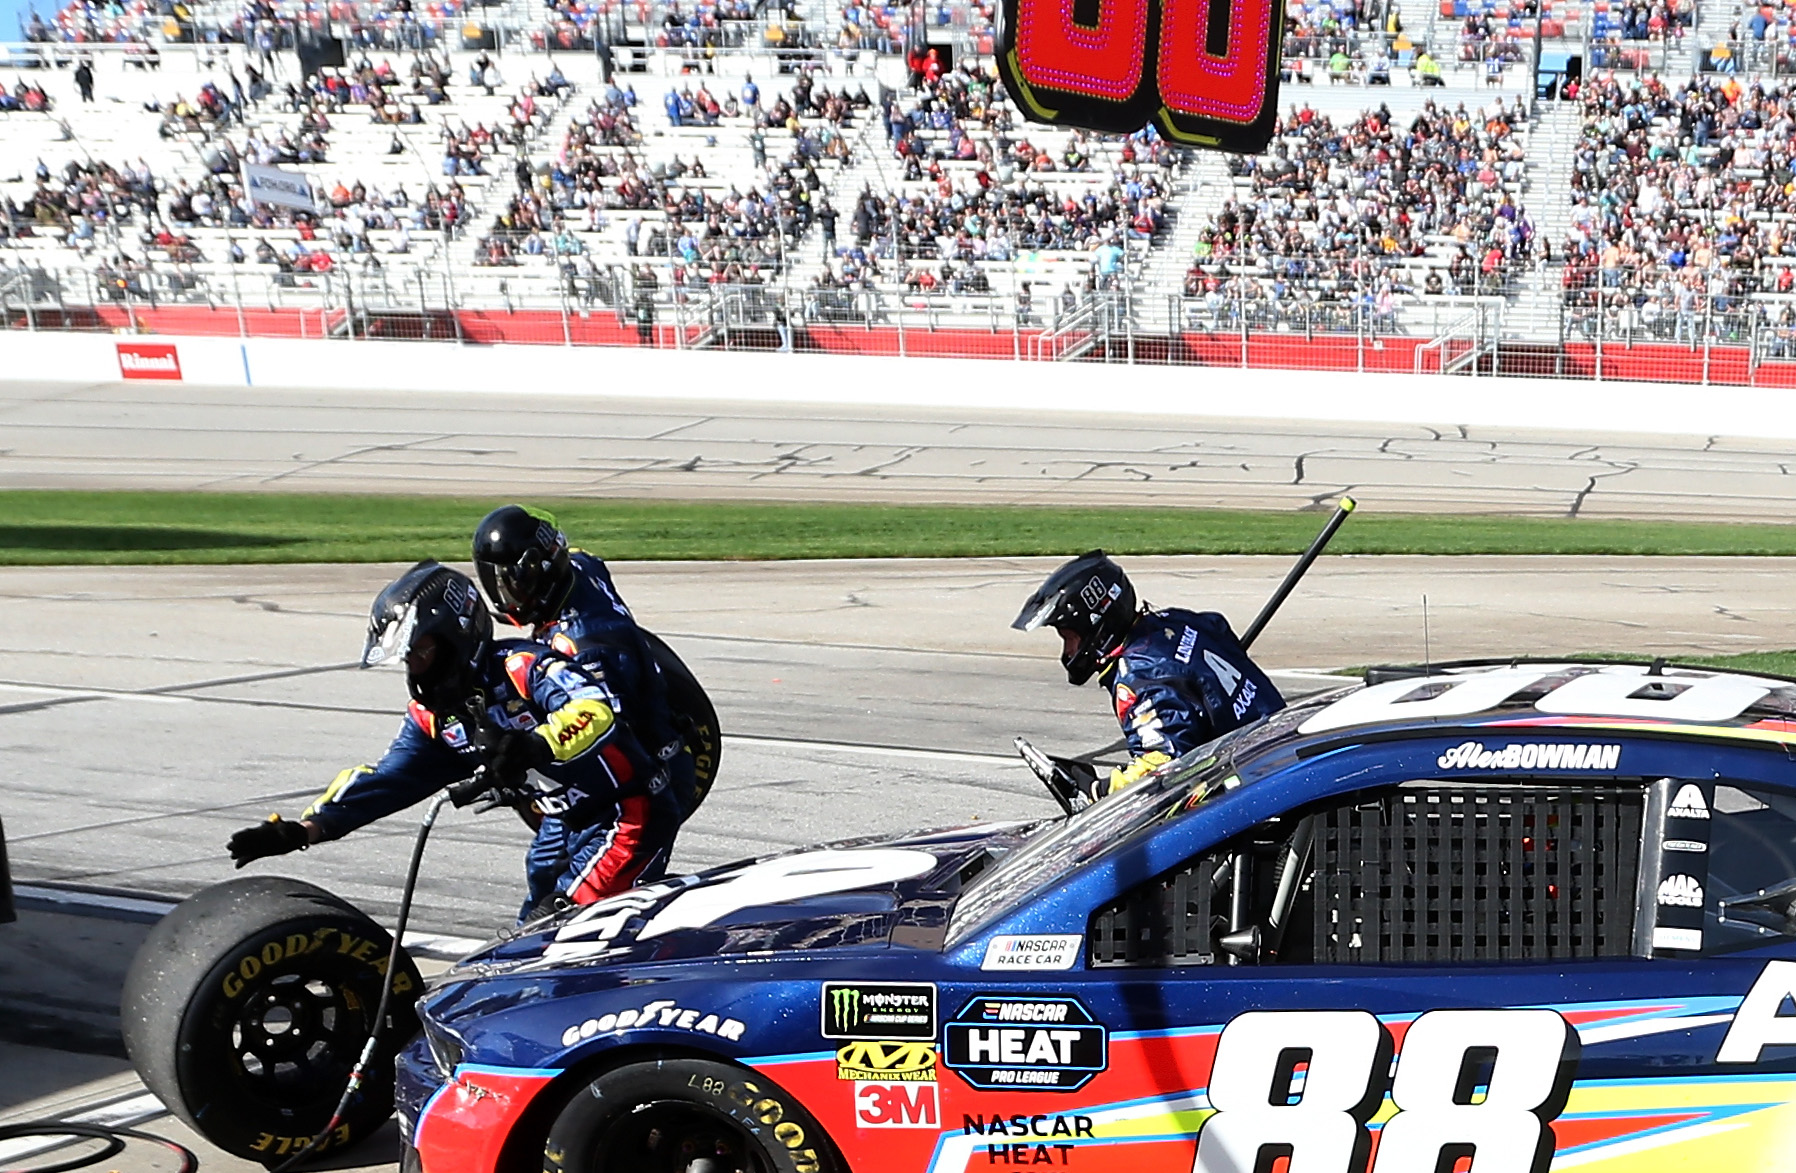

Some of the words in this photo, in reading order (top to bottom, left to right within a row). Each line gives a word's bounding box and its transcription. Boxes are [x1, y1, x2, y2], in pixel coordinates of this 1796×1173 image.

[119, 352, 177, 371] Rinnai
[1080, 575, 1106, 610] 88
[1231, 679, 1259, 721] AXALT
[1436, 741, 1508, 770] Alex
[1503, 743, 1622, 770] BOWMAN
[1666, 806, 1711, 820] AXALTA
[1657, 873, 1704, 898] MAC
[1657, 895, 1704, 908] TOOLS
[1014, 939, 1067, 952] NASCAR
[221, 926, 414, 1000] GOODYEAR
[997, 954, 1032, 965] RACE
[1035, 954, 1062, 965] CAR
[862, 992, 930, 1007] MONSTER
[561, 1000, 748, 1047] GOODYEAR
[998, 1002, 1068, 1022] NASCAR
[967, 1028, 1081, 1065] HEAT
[838, 1067, 901, 1080] MECHANIX
[901, 1068, 937, 1081] WEAR
[990, 1070, 1016, 1083] PRO
[1015, 1071, 1060, 1085] LEAGUE
[858, 1084, 937, 1125] 3M
[962, 1113, 1095, 1138] NASCAR
[987, 1143, 1075, 1166] HEAT
